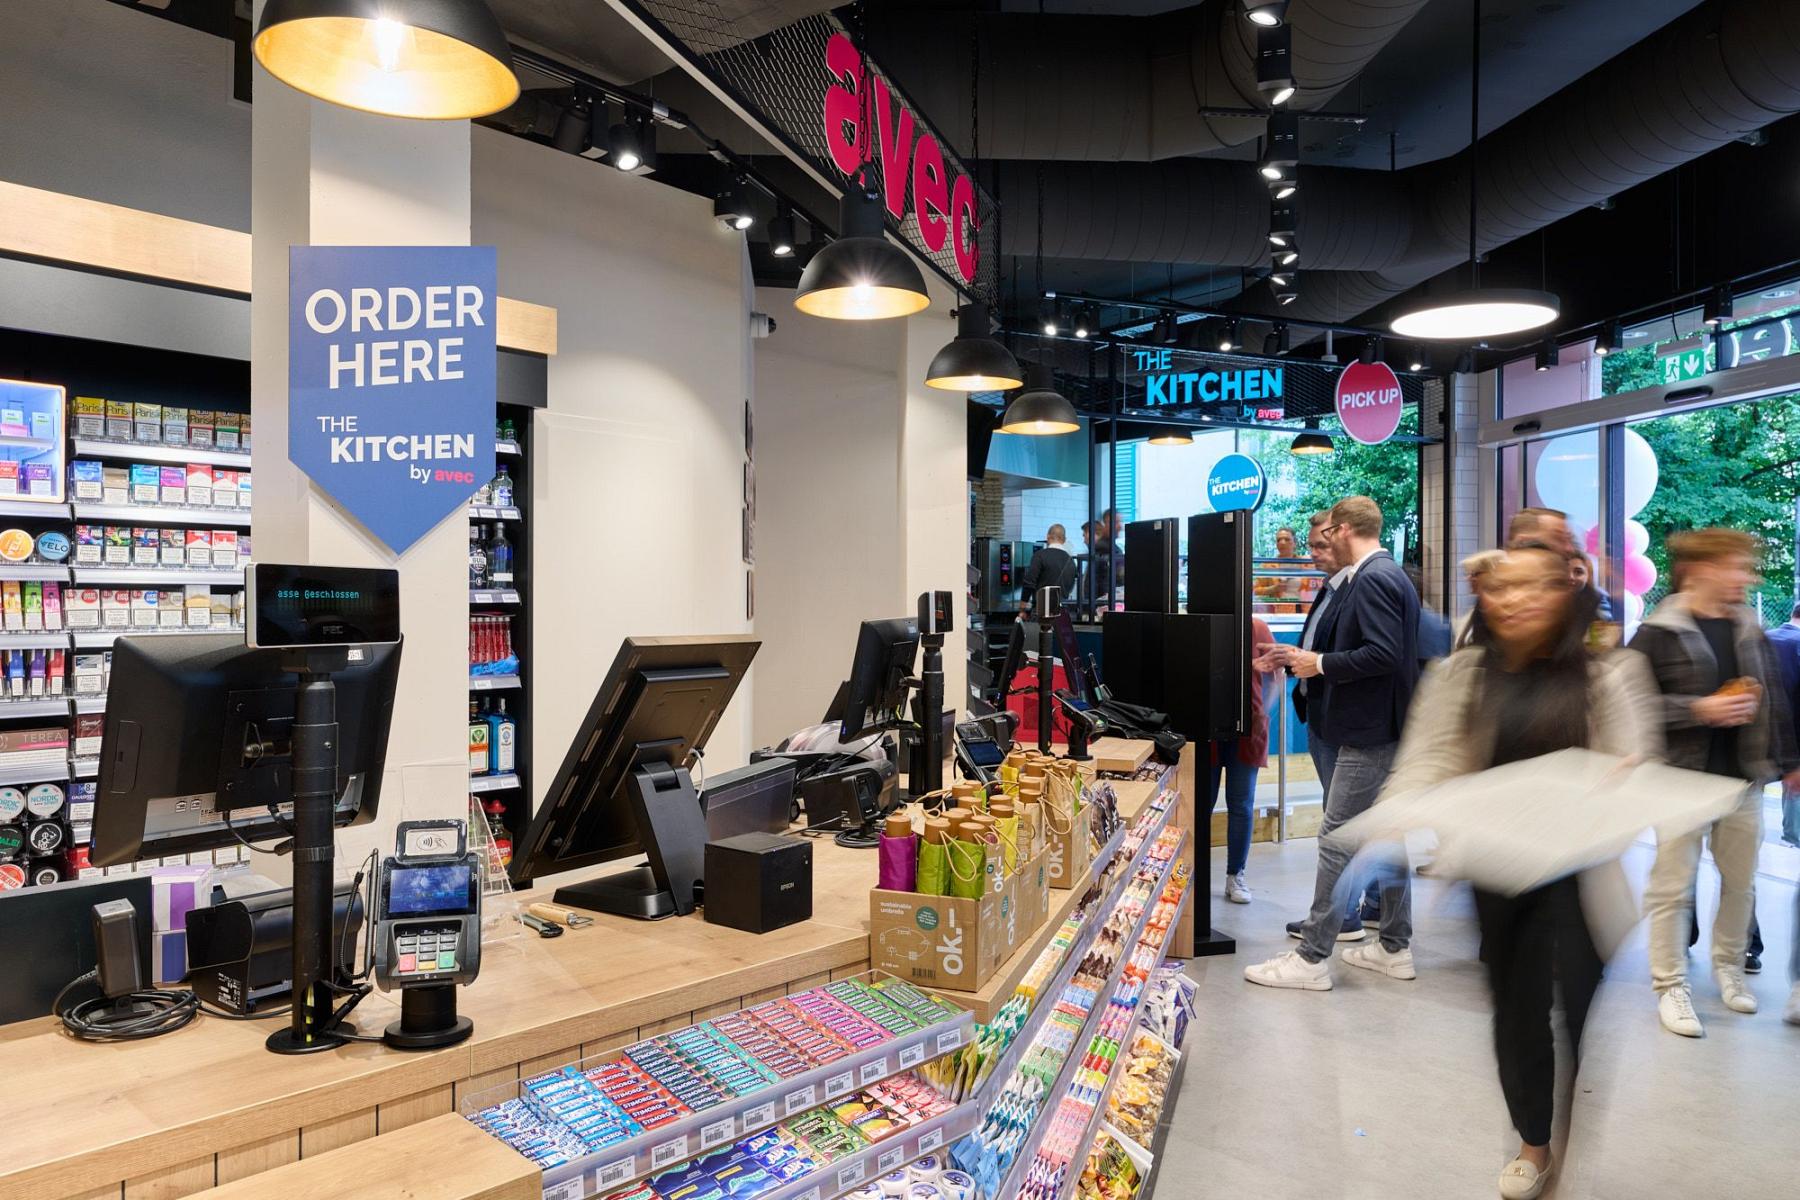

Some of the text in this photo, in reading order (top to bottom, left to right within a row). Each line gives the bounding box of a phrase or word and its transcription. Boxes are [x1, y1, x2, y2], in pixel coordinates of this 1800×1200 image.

[825, 33, 982, 284] avec
[305, 285, 485, 333] ORDER
[329, 337, 464, 389] HERE
[1132, 350, 1172, 371] THE
[1144, 368, 1282, 406] KITCHEN
[1342, 388, 1399, 409] PICK UP
[1244, 405, 1257, 417] by
[316, 416, 358, 432] THE
[330, 434, 474, 463] KITCHEN
[410, 464, 474, 484] by avec
[1212, 475, 1258, 496] KITCHEN
[40, 541, 68, 553] VELO
[277, 589, 360, 600] asse Geschlossen
[22, 732, 64, 743] TEREA
[31, 794, 59, 803] NORDIC
[669, 1026, 698, 1040] STIMOROL
[678, 1034, 707, 1047] STIMOROL
[856, 1034, 883, 1047] STIMOROL
[624, 1040, 655, 1054] STIMOROL
[687, 1041, 715, 1054] STIMOROL
[633, 1048, 663, 1062] STIMOROL
[696, 1048, 725, 1062] STIMOROL
[642, 1056, 672, 1070] STIMOROL
[650, 1062, 682, 1078] STIMOROL
[715, 1062, 745, 1076] STIMOROL
[524, 1071, 558, 1086] STIMOROL
[596, 1072, 626, 1085] STIMOROL
[660, 1070, 692, 1085] STIMOROL
[724, 1070, 754, 1084] STIMOROL
[734, 1077, 764, 1091] STIMOROL
[604, 1079, 637, 1093] STIMOROL
[669, 1078, 701, 1092] STIMOROL
[612, 1087, 646, 1101] STIMOROL
[678, 1086, 711, 1100] STIMOROL
[688, 1093, 720, 1108] STIMOROL
[622, 1094, 656, 1109] STIMOROL
[828, 1093, 858, 1109] STIMOROL
[632, 1102, 666, 1118] STIMOROL
[852, 1109, 882, 1126] STIMOROL
[642, 1111, 675, 1126] STIMOROL
[794, 1117, 822, 1133] STIMOROL
[590, 1130, 623, 1146] STIMOROL
[816, 1133, 845, 1148] STIMOROL
